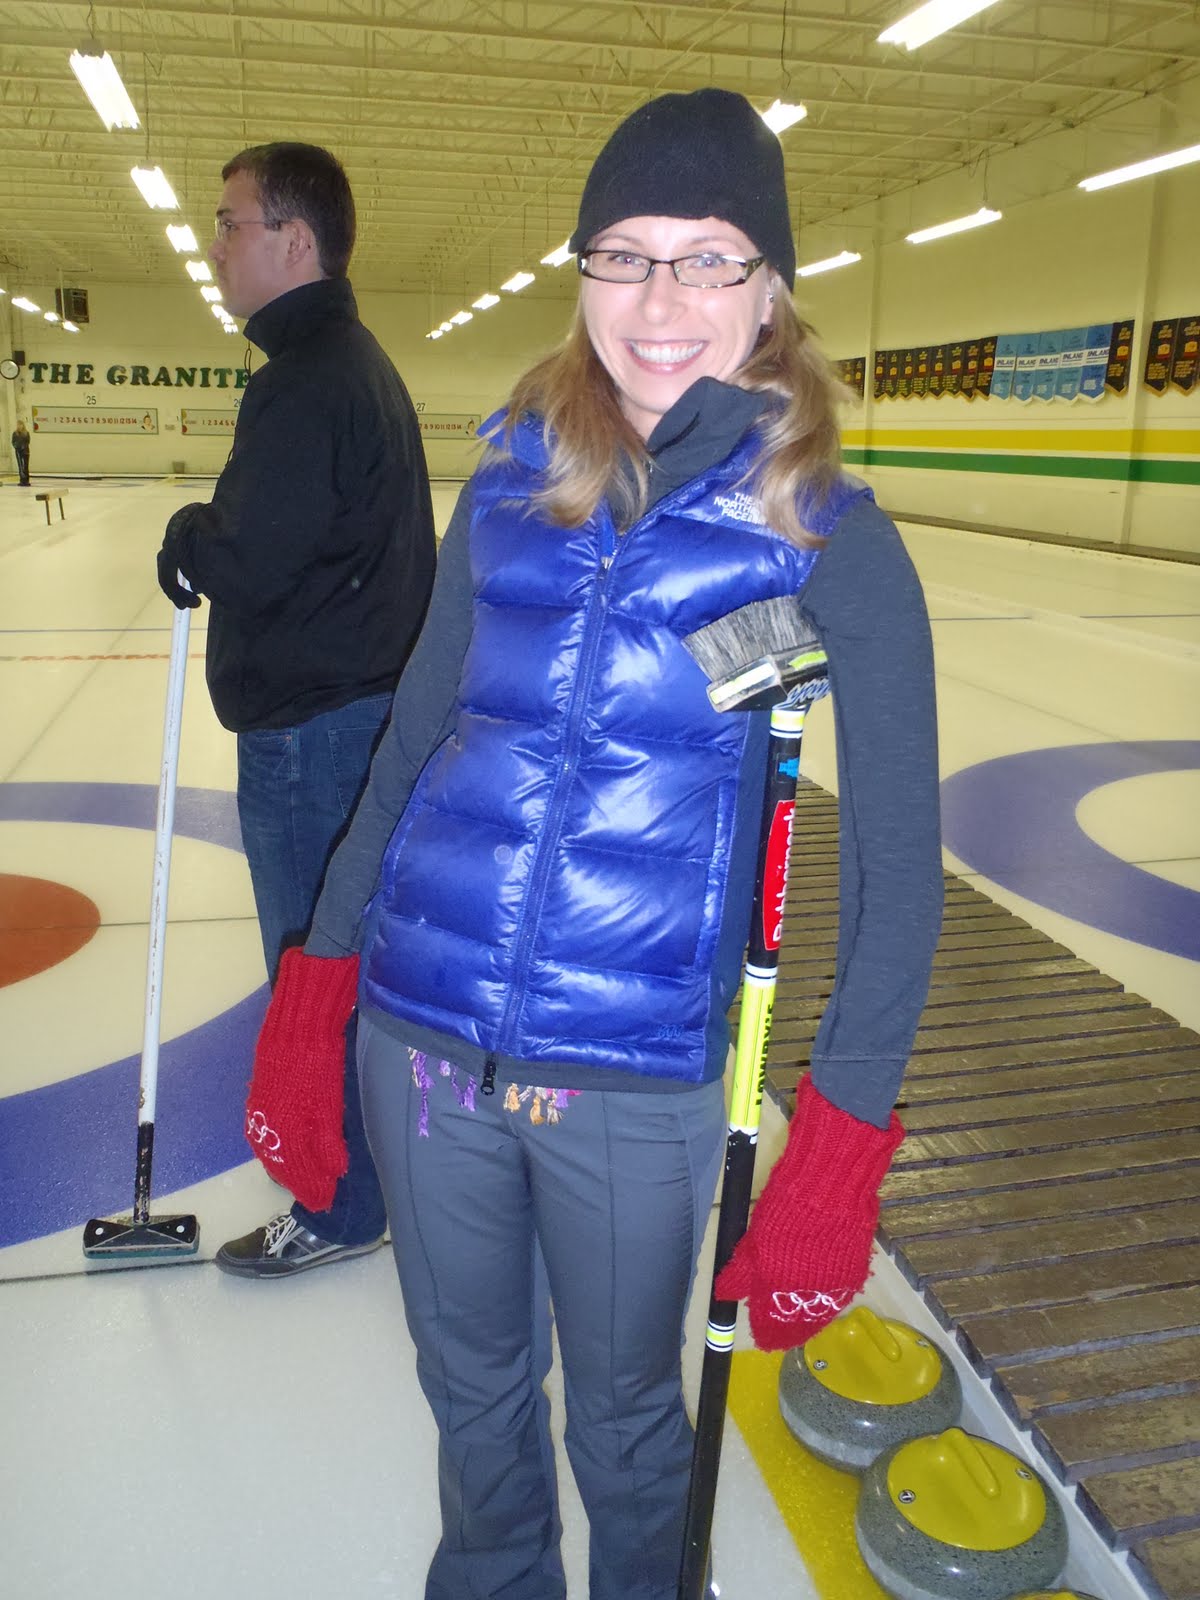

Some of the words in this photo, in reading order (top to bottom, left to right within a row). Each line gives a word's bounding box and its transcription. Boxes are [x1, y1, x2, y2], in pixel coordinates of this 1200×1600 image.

[28, 362, 95, 385] THE
[106, 364, 250, 388] GRANITE
[86, 395, 97, 405] 25
[416, 402, 426, 412] 27
[713, 495, 752, 513] NORTH
[734, 492, 754, 506] THE
[721, 508, 749, 522] FACE
